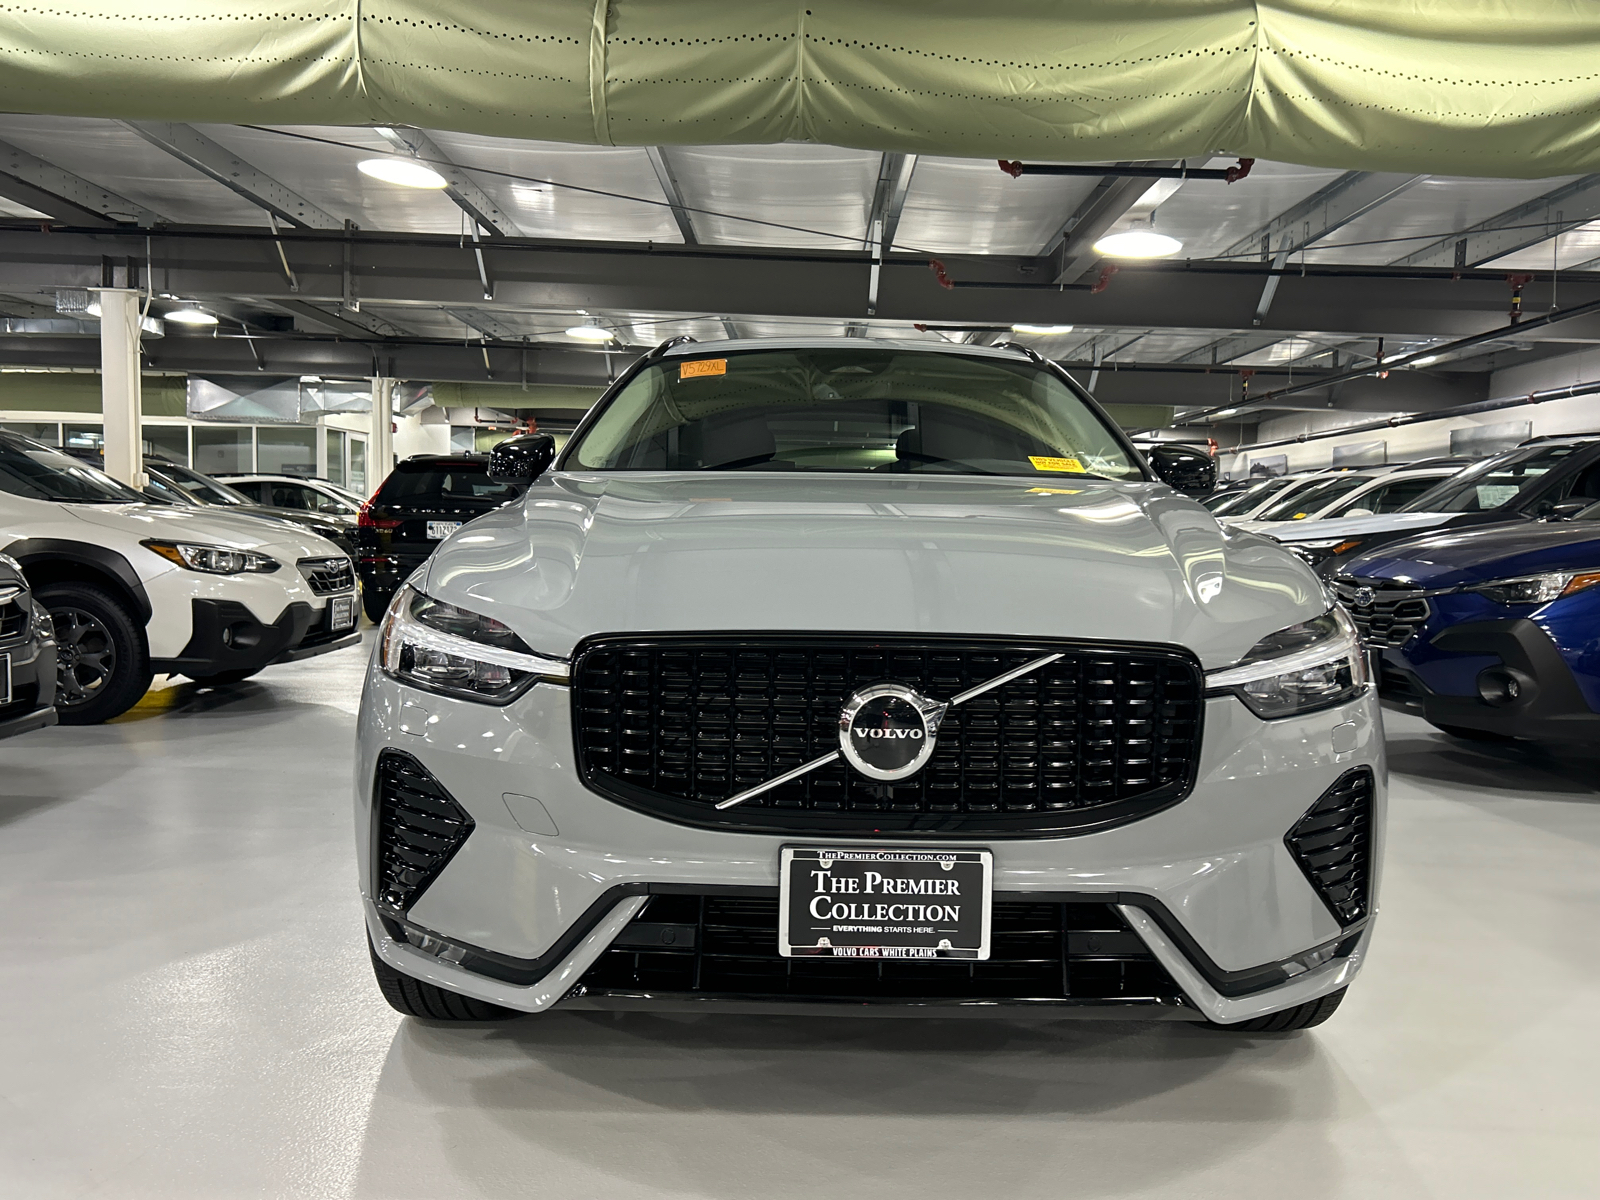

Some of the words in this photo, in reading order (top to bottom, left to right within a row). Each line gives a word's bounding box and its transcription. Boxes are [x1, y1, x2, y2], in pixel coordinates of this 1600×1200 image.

[853, 728, 923, 739] VOLVO
[810, 870, 859, 894] THE
[863, 871, 961, 896] PREMIER
[809, 896, 961, 922] COLLECTION
[833, 925, 882, 933] EVERYTHING
[884, 926, 912, 934] STARTS
[833, 947, 857, 957] VOLVO
[859, 947, 879, 957] CARS
[882, 948, 907, 958] WHITE
[909, 948, 937, 958] PLAINS
